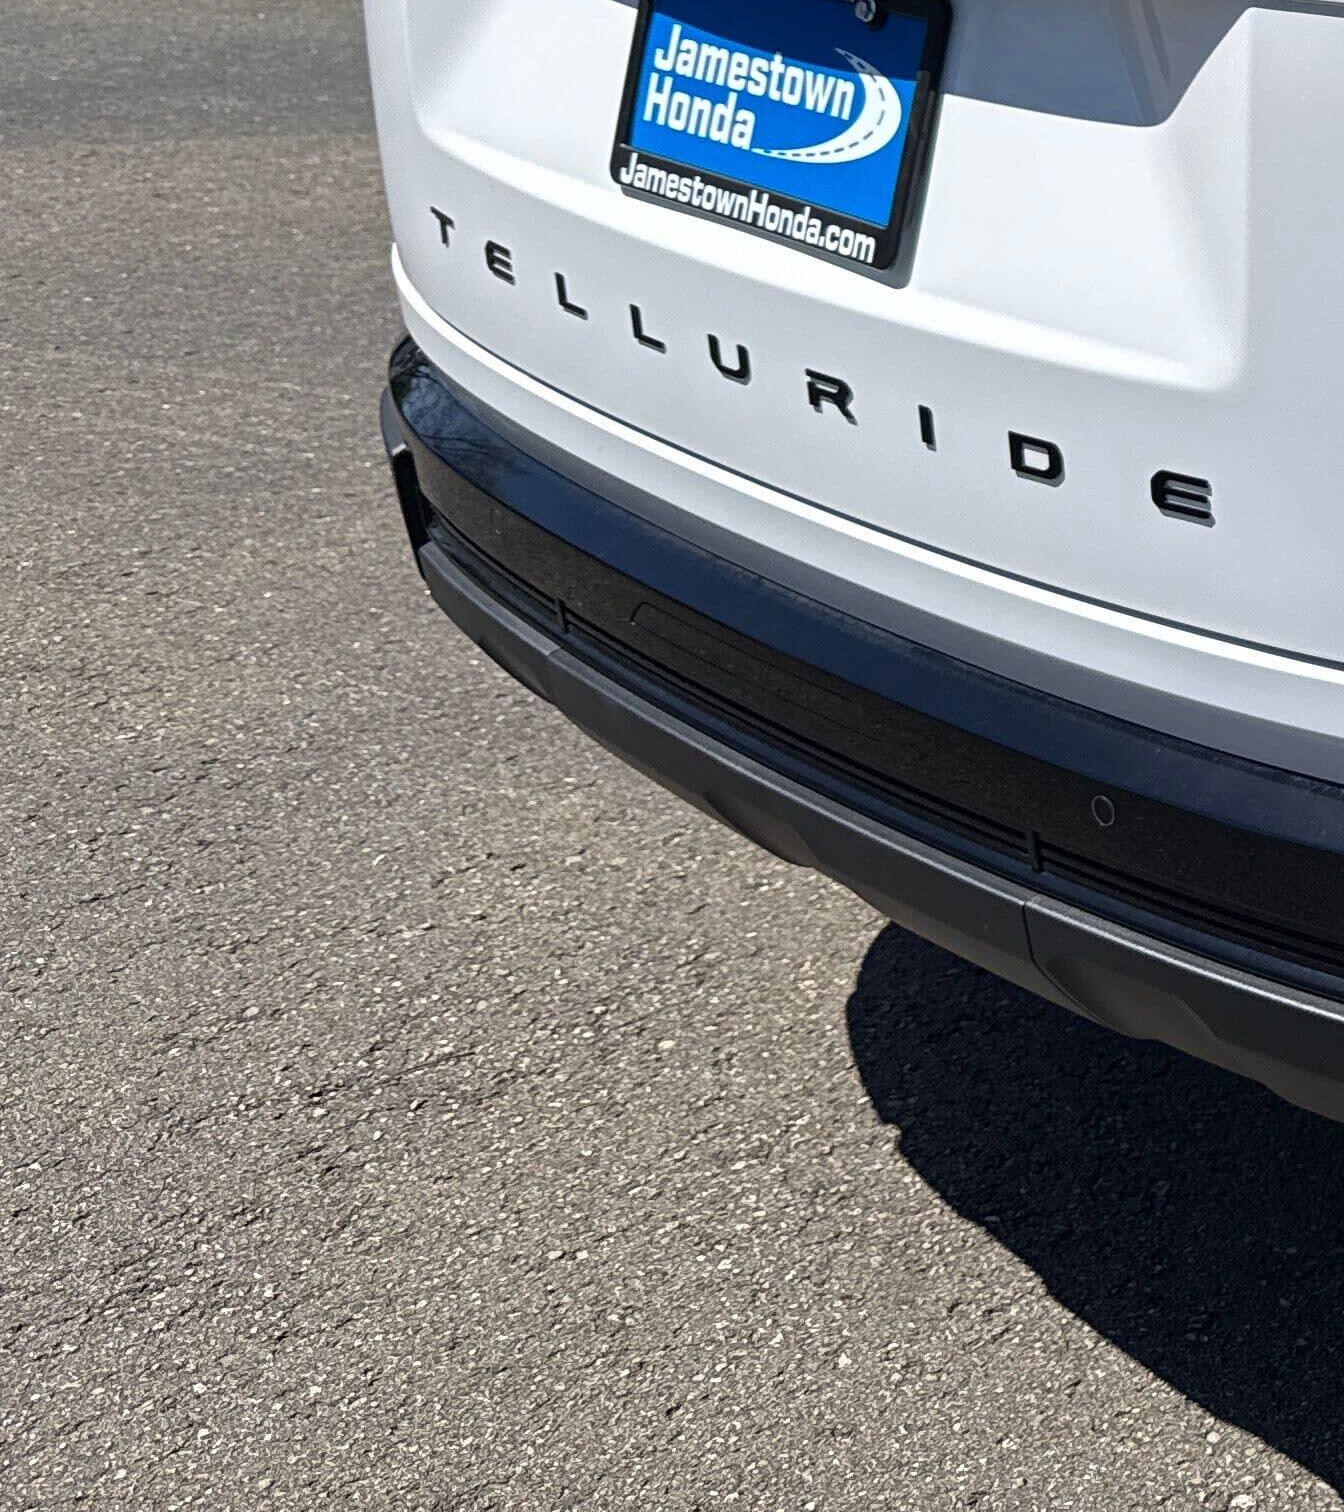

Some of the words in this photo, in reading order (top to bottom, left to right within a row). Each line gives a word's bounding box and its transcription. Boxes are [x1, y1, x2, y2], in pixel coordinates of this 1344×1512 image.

[643, 71, 757, 151] Honda
[653, 22, 856, 122] Jamestown
[619, 152, 877, 264] JamestownHonda.com
[429, 205, 1217, 527] TELLURIDE
